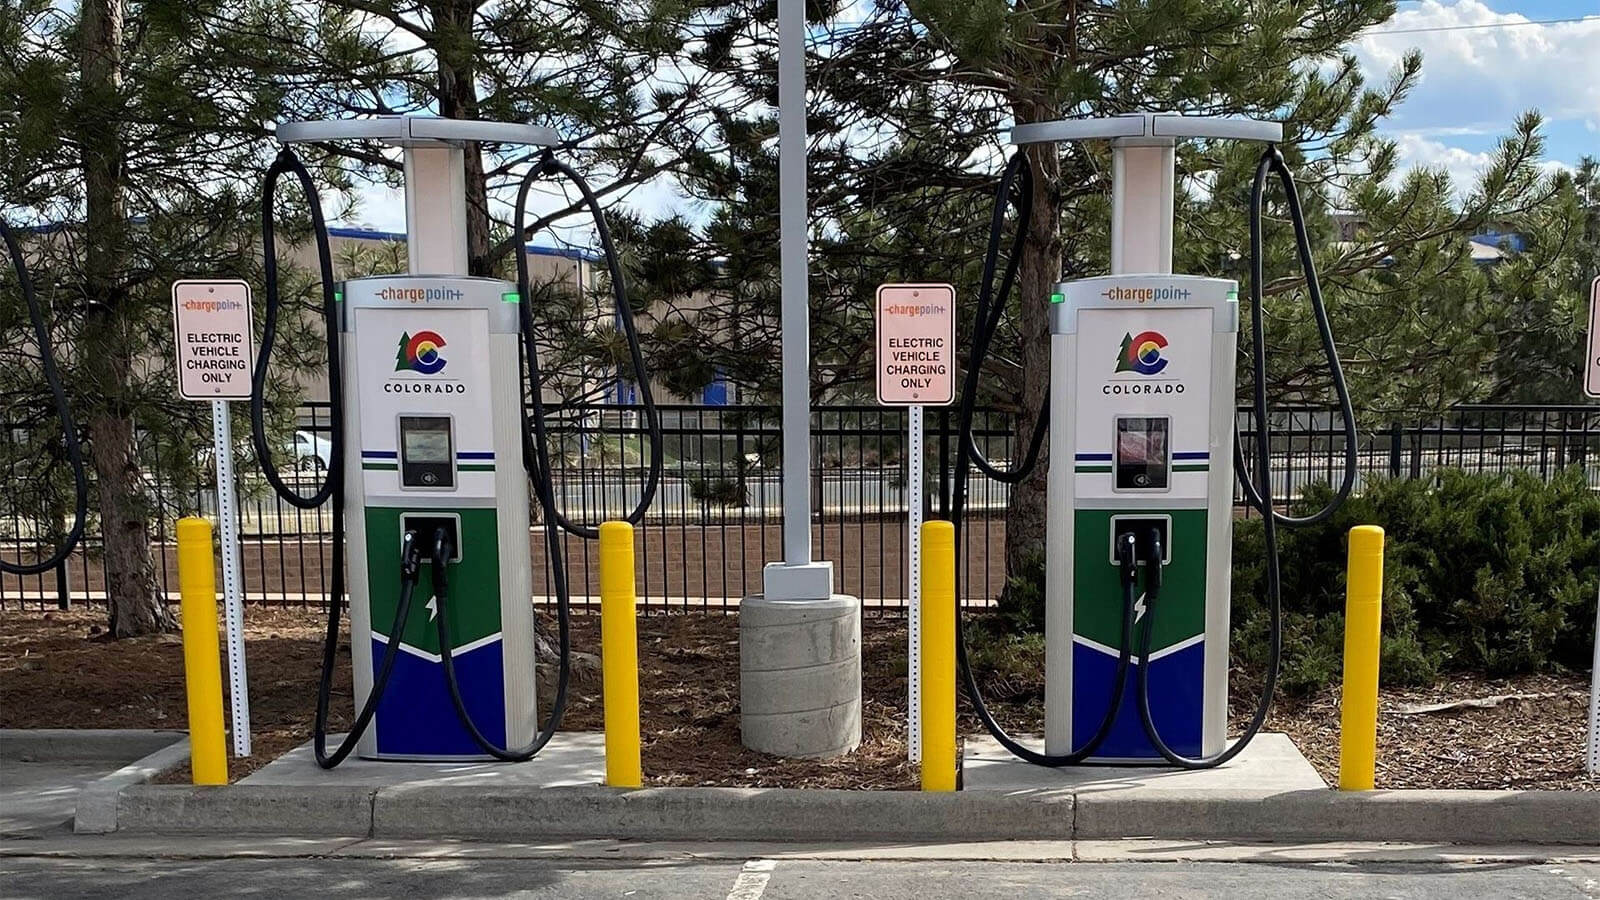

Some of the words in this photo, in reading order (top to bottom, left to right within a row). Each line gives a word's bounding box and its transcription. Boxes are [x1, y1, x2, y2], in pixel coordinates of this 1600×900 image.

[187, 333, 242, 343] ELECTRIC
[888, 338, 944, 348] ELECTRIC
[192, 346, 239, 356] VEHICLE
[892, 351, 940, 361] VEHICLE
[186, 360, 246, 370] CHARGING
[886, 365, 946, 375] CHARGING
[201, 373, 232, 383] ONLY
[901, 378, 931, 388] ONLY
[384, 383, 466, 394] COLORADO
[1102, 384, 1185, 395] COLORADO
